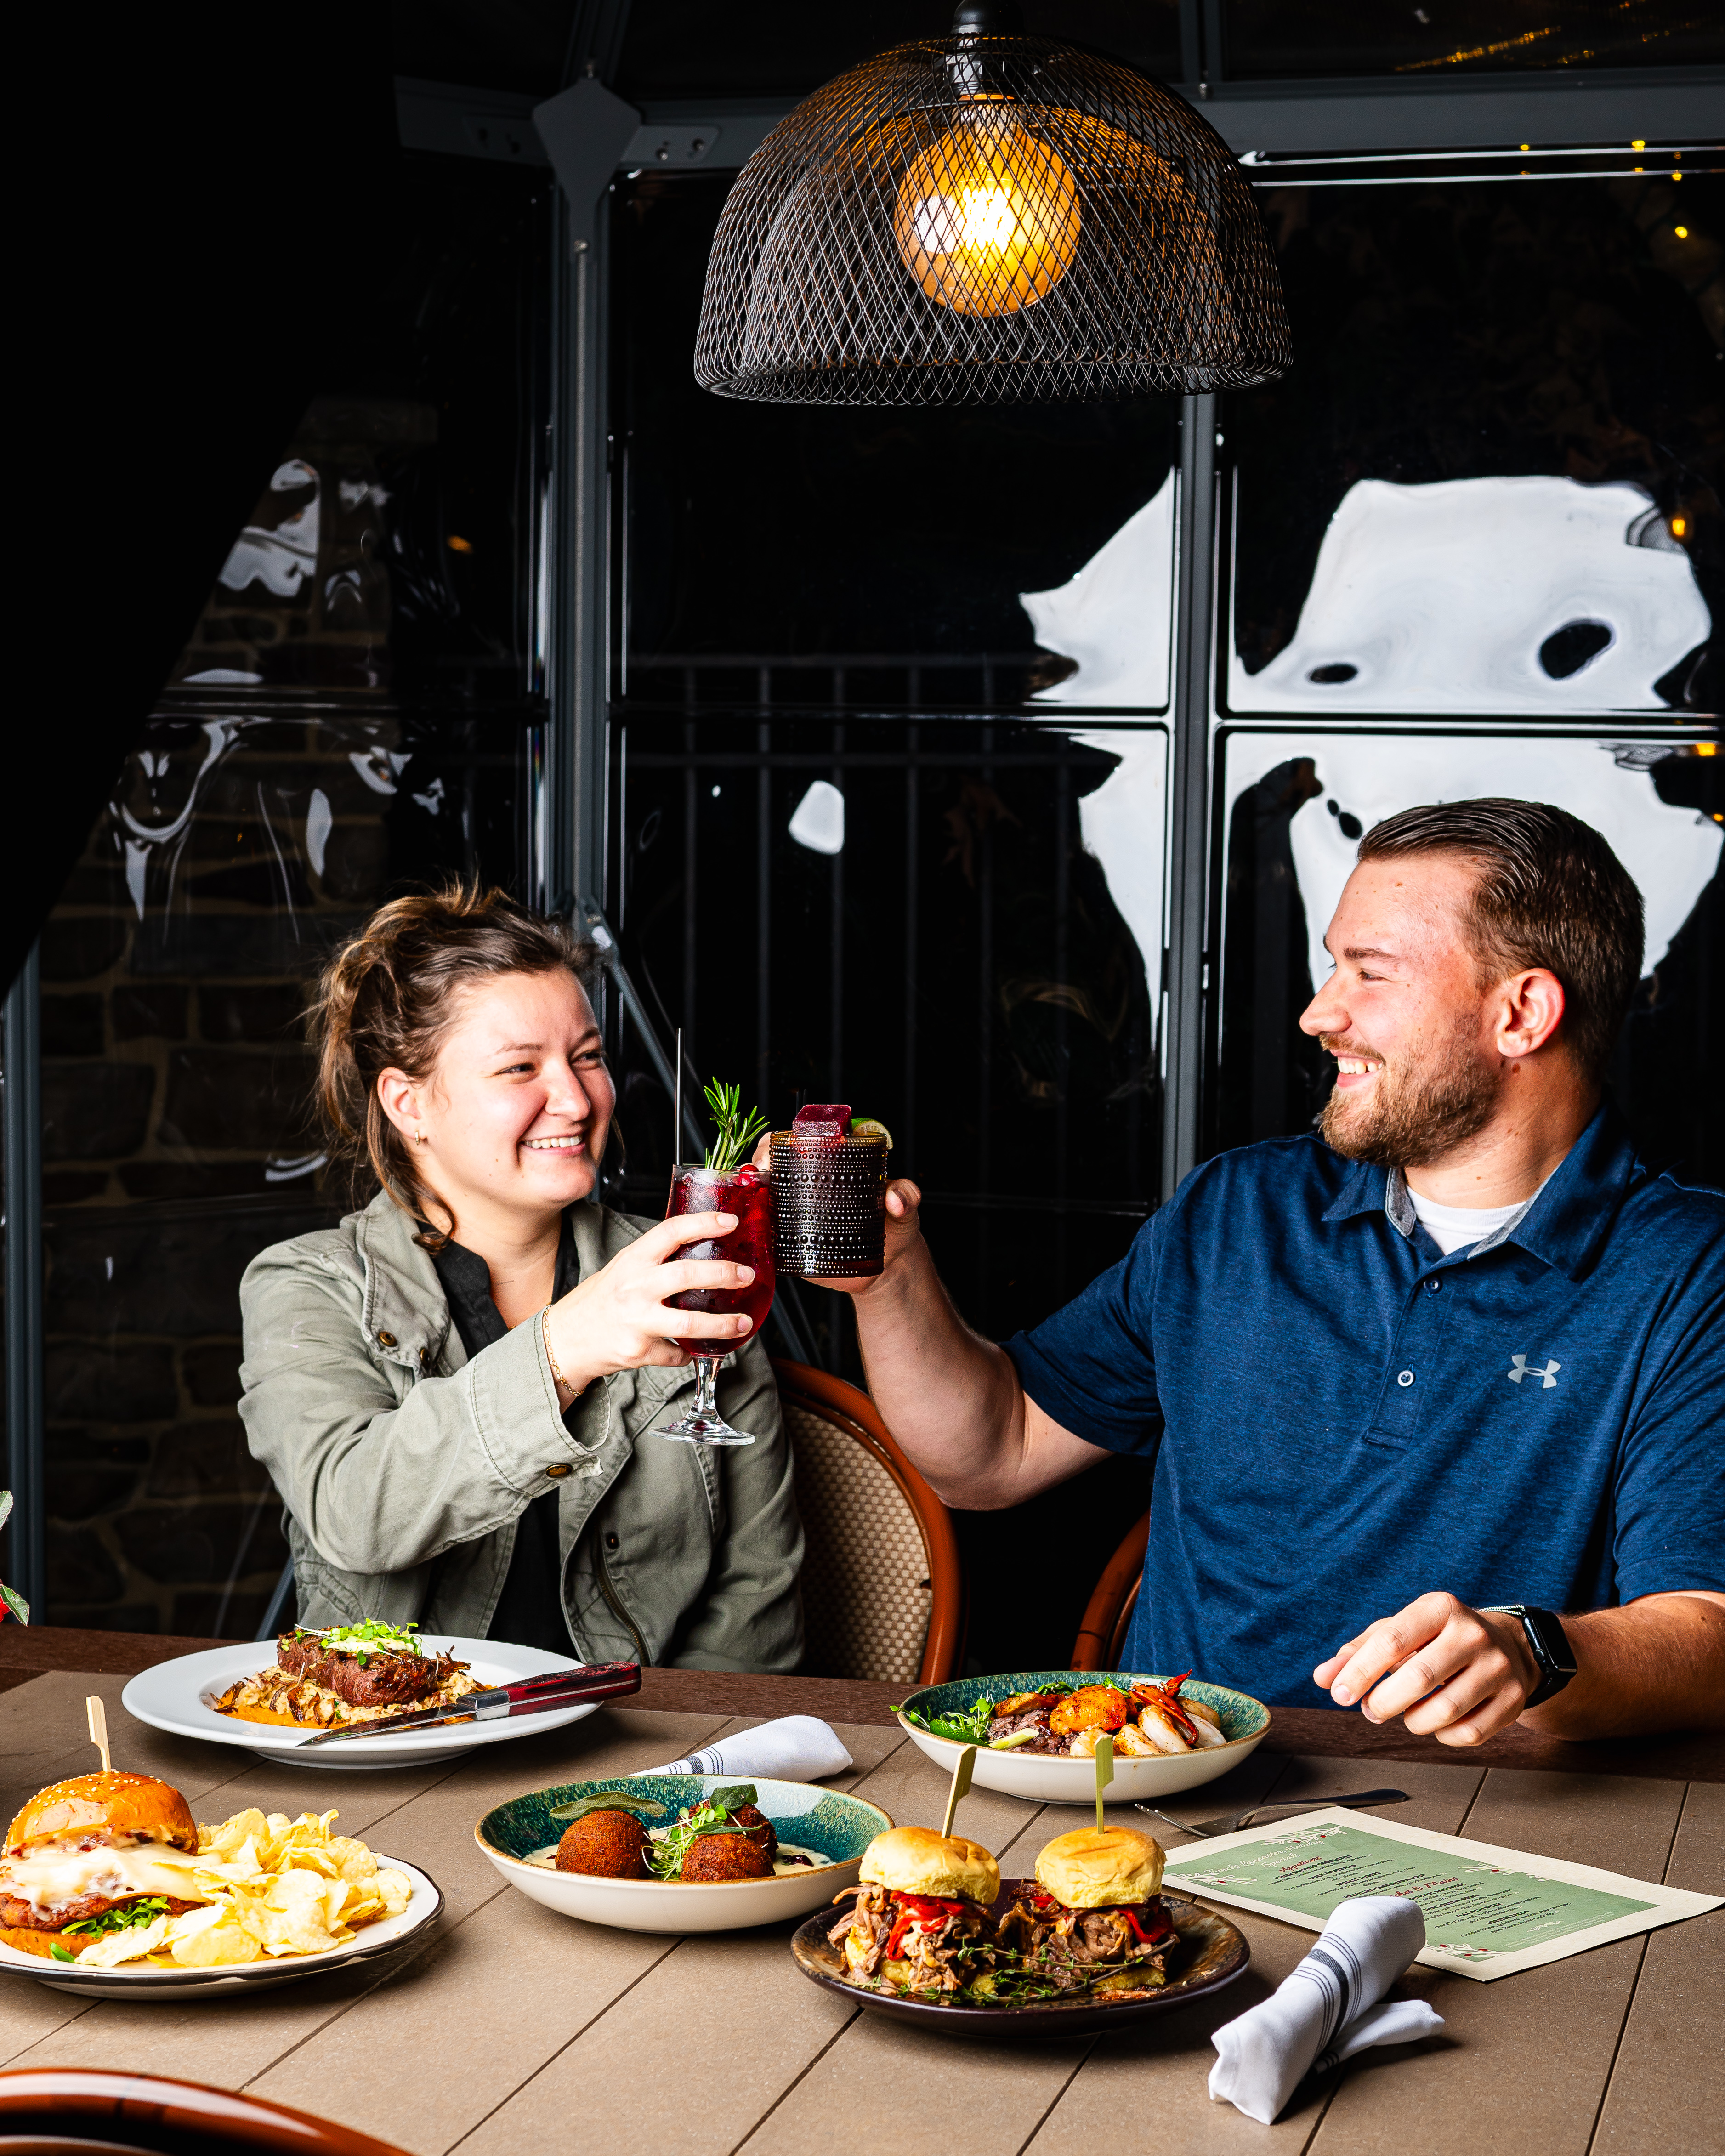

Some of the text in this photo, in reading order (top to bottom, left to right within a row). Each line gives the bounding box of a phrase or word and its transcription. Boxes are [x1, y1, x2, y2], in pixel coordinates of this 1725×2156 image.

[1240, 1850, 1287, 1866] Lancaster,
[1285, 1840, 1325, 1851] Holiday
[1261, 1853, 1300, 1868] Specials
[1317, 1855, 1352, 1865] CROQUETTES
[1279, 1856, 1322, 1872] Appetizers
[1324, 1865, 1357, 1874] MEATBALLS
[1342, 1889, 1375, 1898] TORTELLINI
[1374, 1879, 1411, 1889] CARBONARA
[1424, 1877, 1458, 1888] Mains
[1408, 1883, 1466, 1901] CHNITZEL SANDWICH
[1486, 1916, 1512, 1924] LOBSTER
